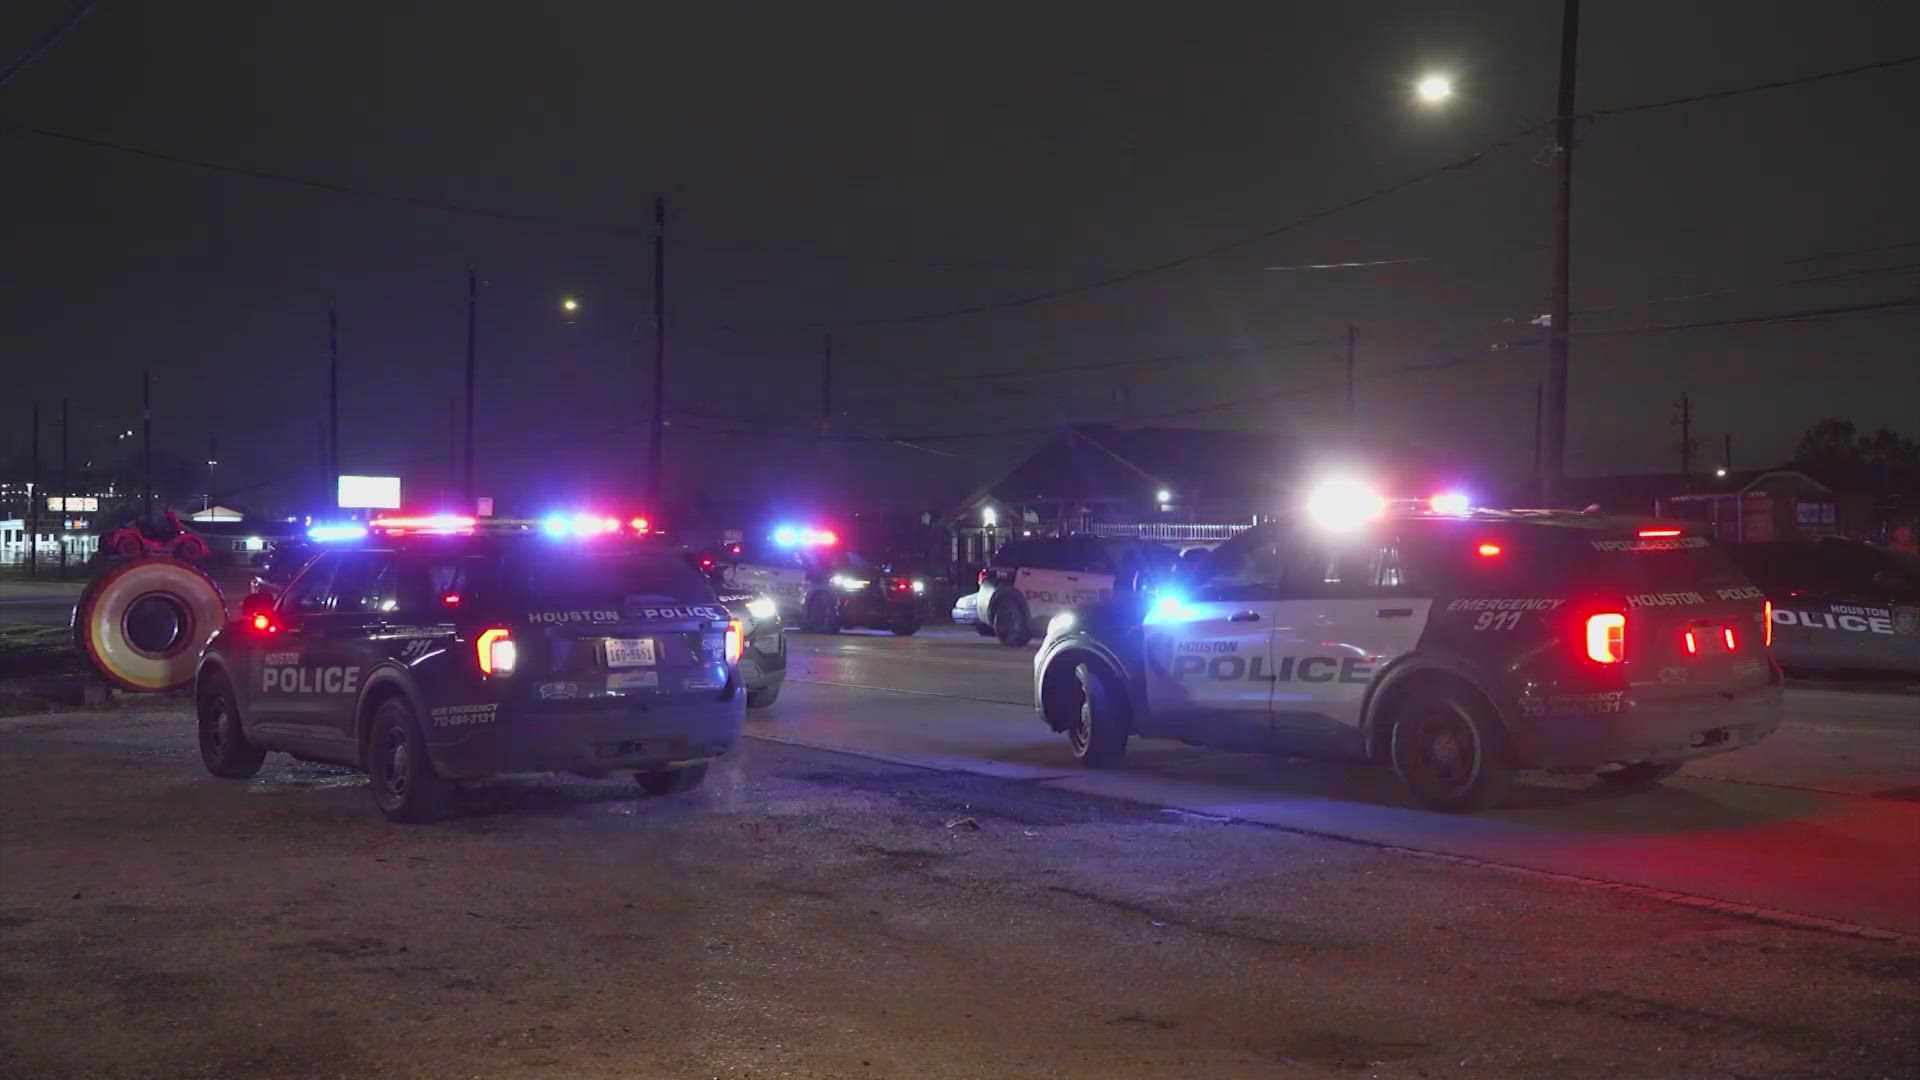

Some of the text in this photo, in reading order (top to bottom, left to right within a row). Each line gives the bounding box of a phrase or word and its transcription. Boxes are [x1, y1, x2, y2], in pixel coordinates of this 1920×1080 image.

[1447, 598, 1567, 611] EMERGENCY
[1626, 592, 1705, 608] HOUSTON
[528, 606, 720, 624] HOUSTON POLICE
[1830, 604, 1890, 617] HOUSTON
[1473, 611, 1523, 631] 911
[1771, 609, 1895, 635] OLICE
[1177, 641, 1238, 653] HOUSTON
[1173, 656, 1373, 684] POLICE
[263, 666, 361, 693] POLICE
